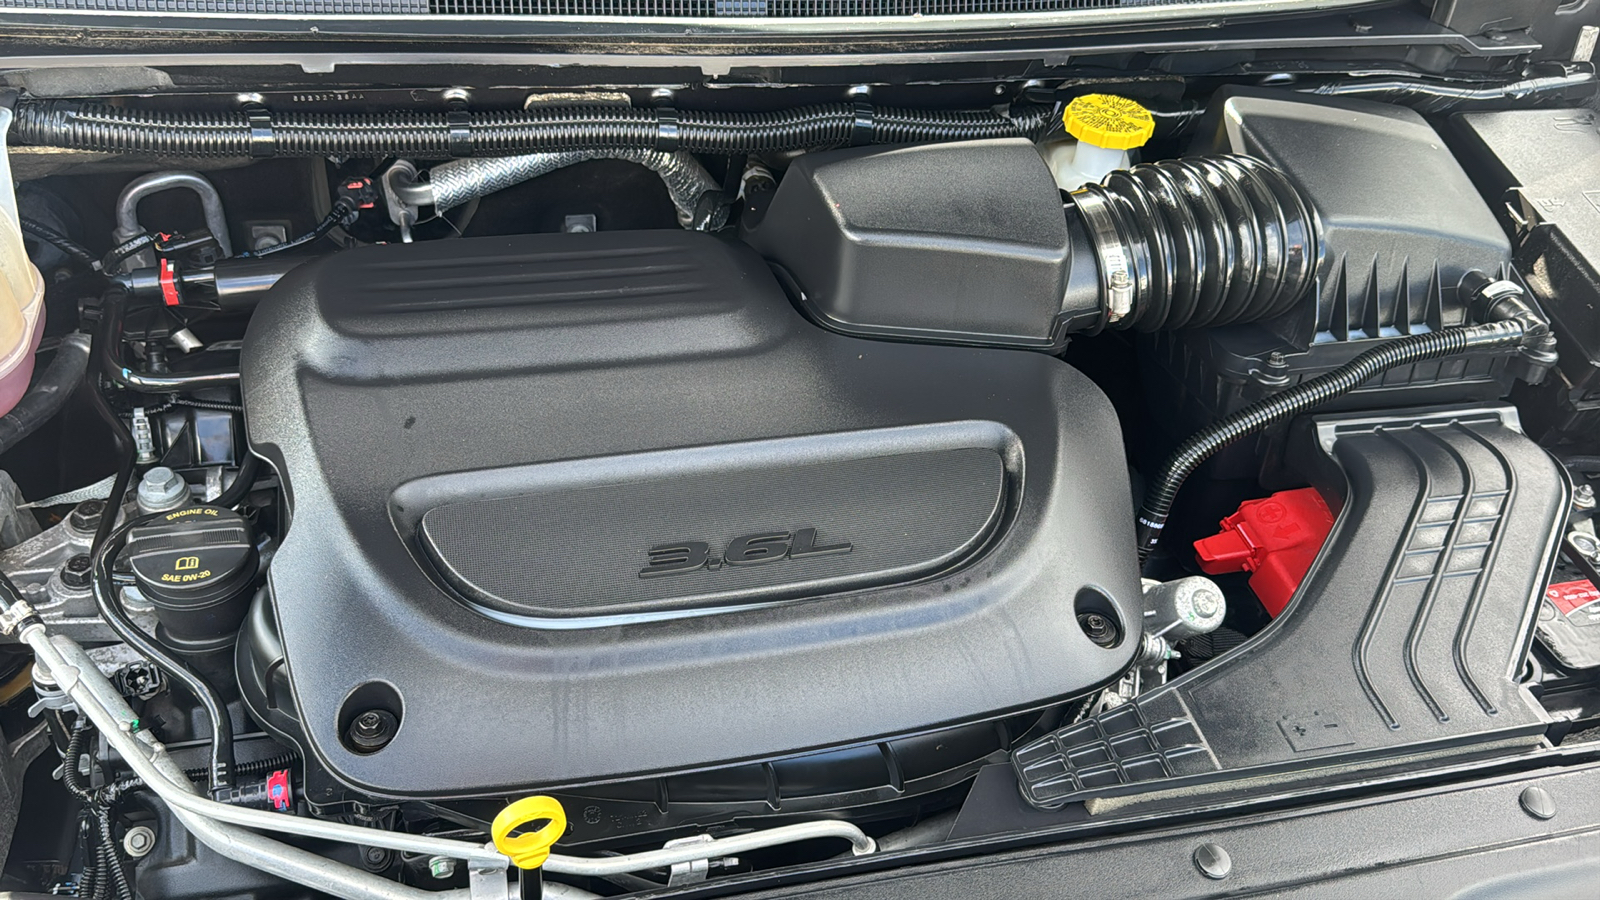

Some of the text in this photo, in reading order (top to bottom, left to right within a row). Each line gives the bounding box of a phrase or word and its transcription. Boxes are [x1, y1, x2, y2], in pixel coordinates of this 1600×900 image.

[166, 508, 219, 520] ENGINE OIL
[638, 527, 853, 579] 3.6L
[161, 569, 211, 583] SAE 0W-20
